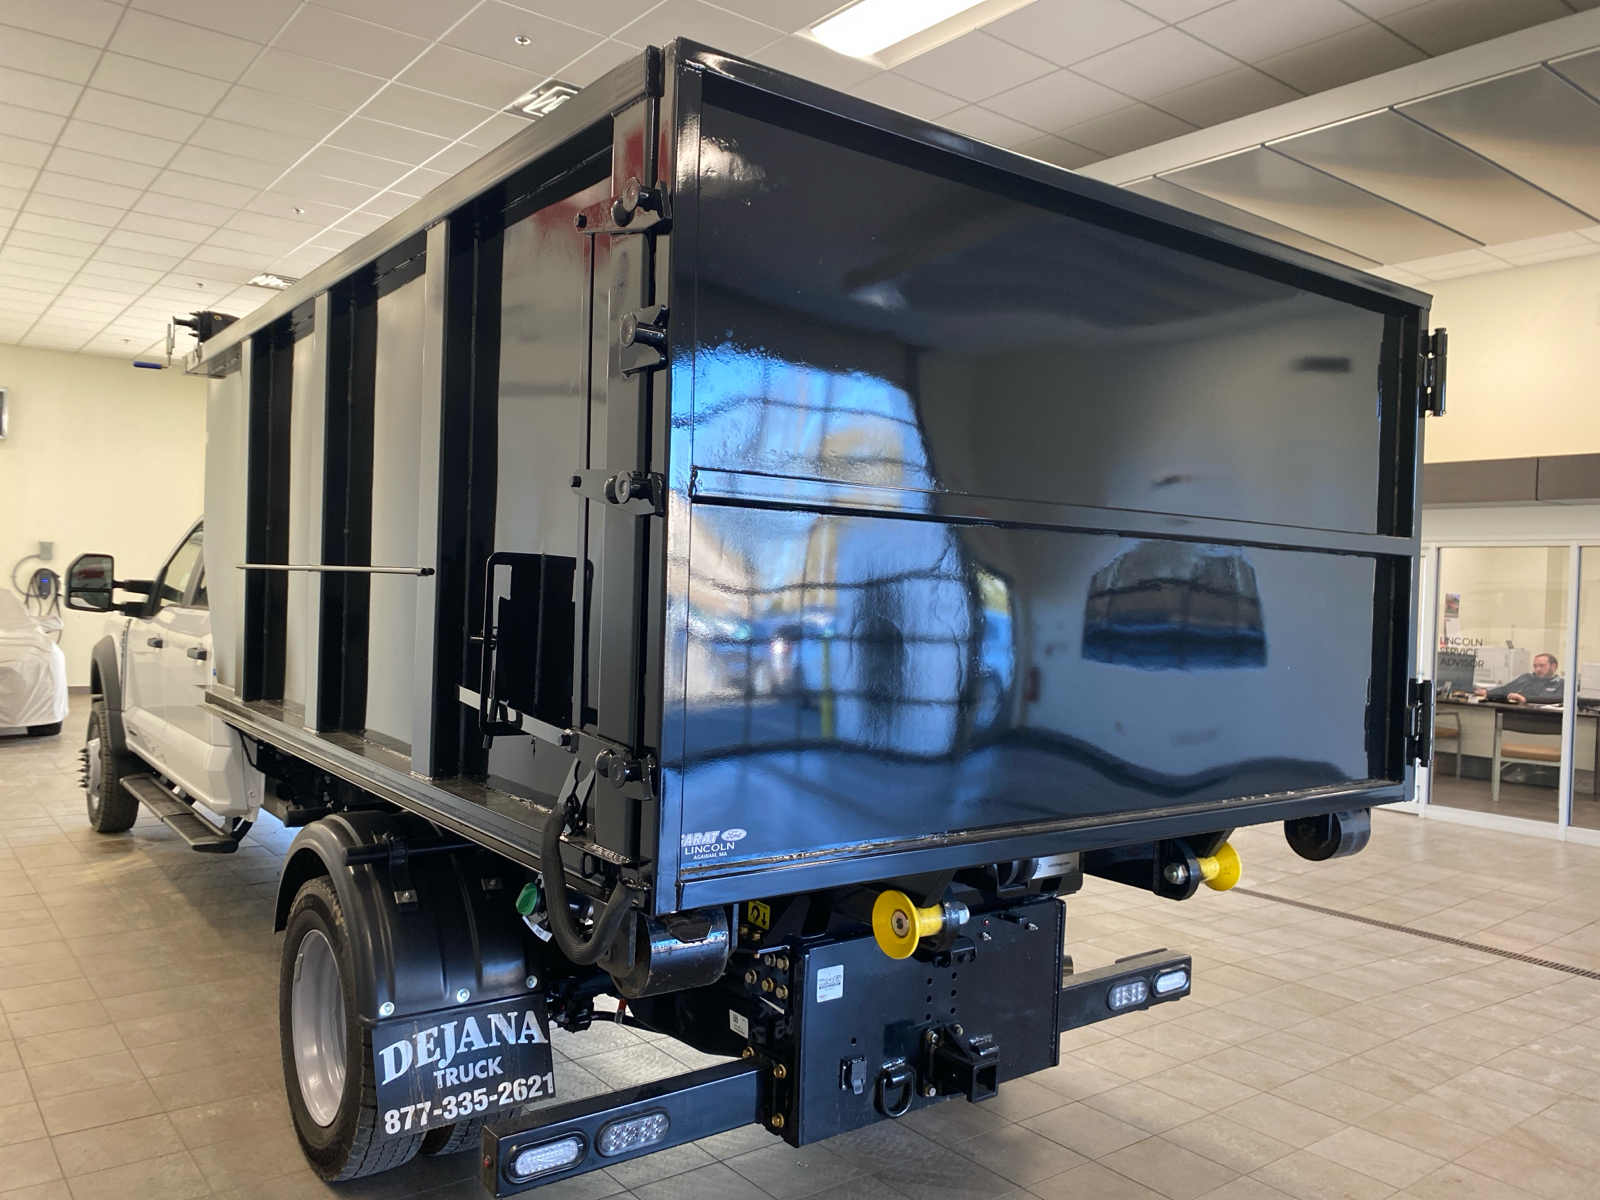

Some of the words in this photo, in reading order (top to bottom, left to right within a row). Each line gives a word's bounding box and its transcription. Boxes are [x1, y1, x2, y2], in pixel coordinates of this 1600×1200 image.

[1440, 636, 1483, 646] LINCOLN
[1440, 647, 1479, 657] SERVICE
[1440, 657, 1484, 668] ADVISOR
[685, 842, 735, 855] LINCOLN
[378, 1010, 548, 1085] DEJANA
[433, 1056, 504, 1089] TRUCK
[384, 1072, 554, 1135] 877-335-2621
